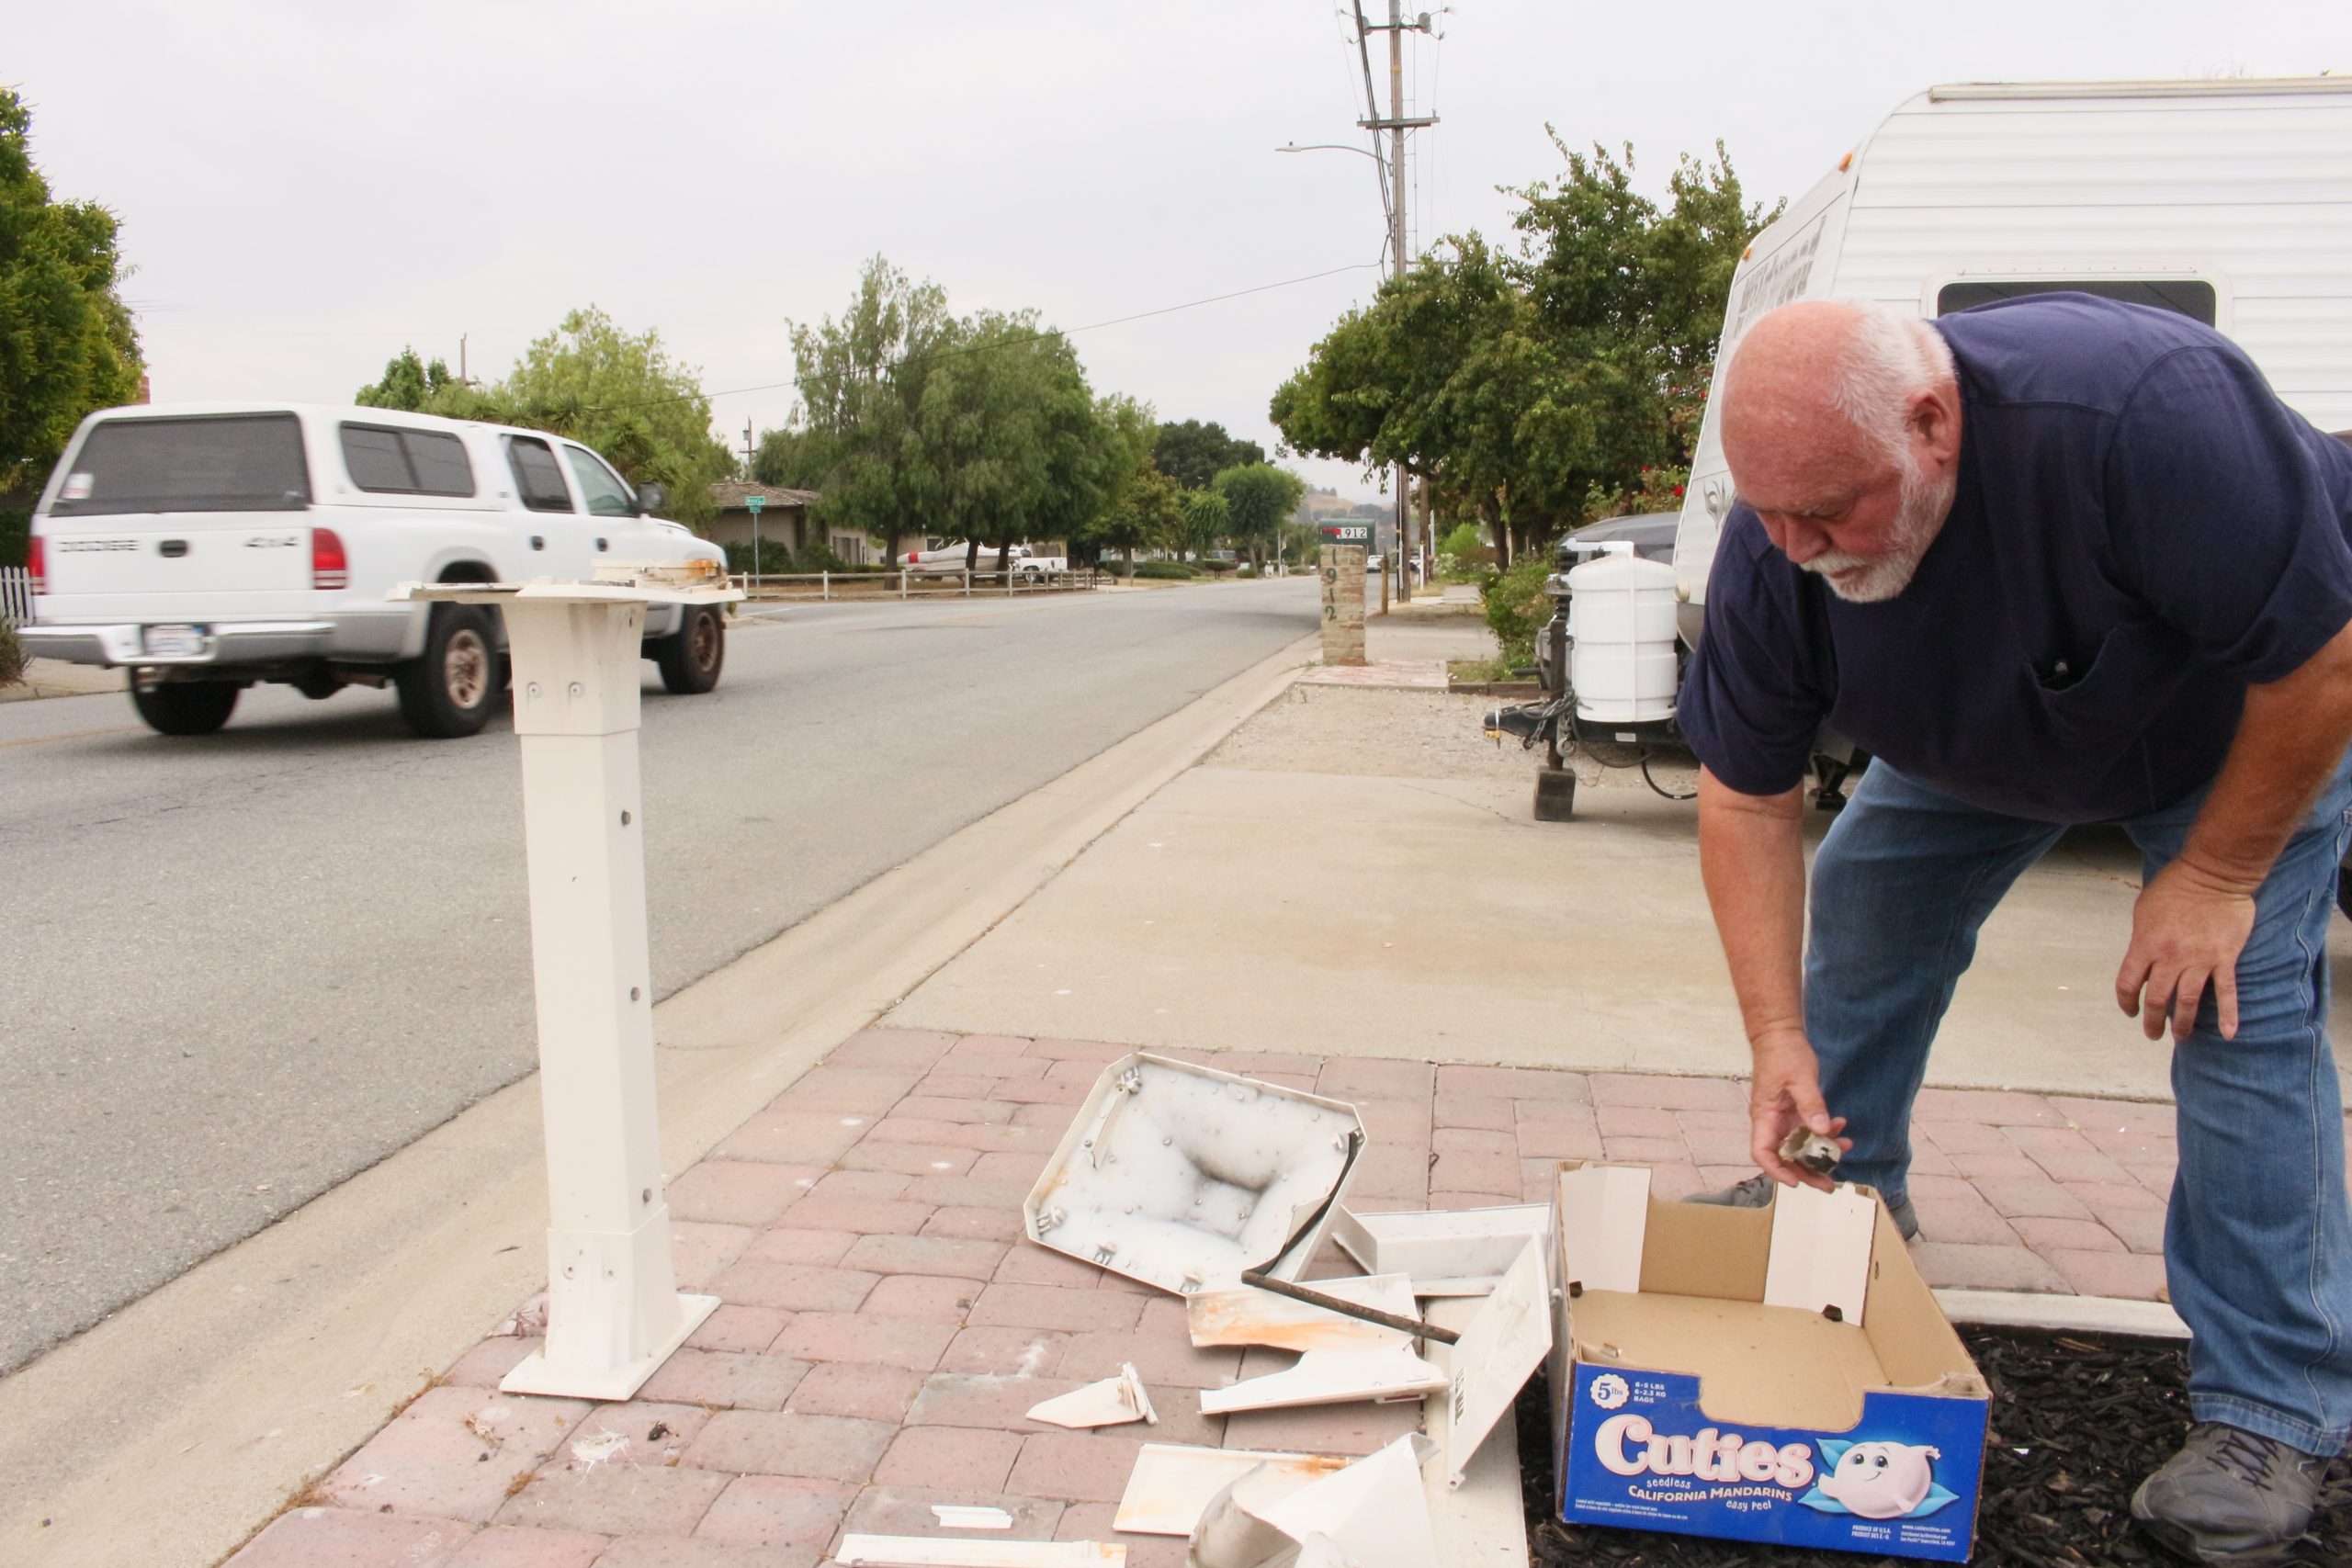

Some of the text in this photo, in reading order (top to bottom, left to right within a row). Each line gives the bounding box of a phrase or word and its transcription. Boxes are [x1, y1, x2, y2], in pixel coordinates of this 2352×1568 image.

[1339, 528, 1367, 538] 912
[1650, 1382, 1665, 1391] LBS
[1634, 1395, 1654, 1404] BAGS
[1595, 1414, 1815, 1488] Cuties
[1646, 1477, 1691, 1489] seedless
[1628, 1484, 1792, 1502] CALIFORNIA MANDARINS
[1725, 1499, 1772, 1512] easy peel
